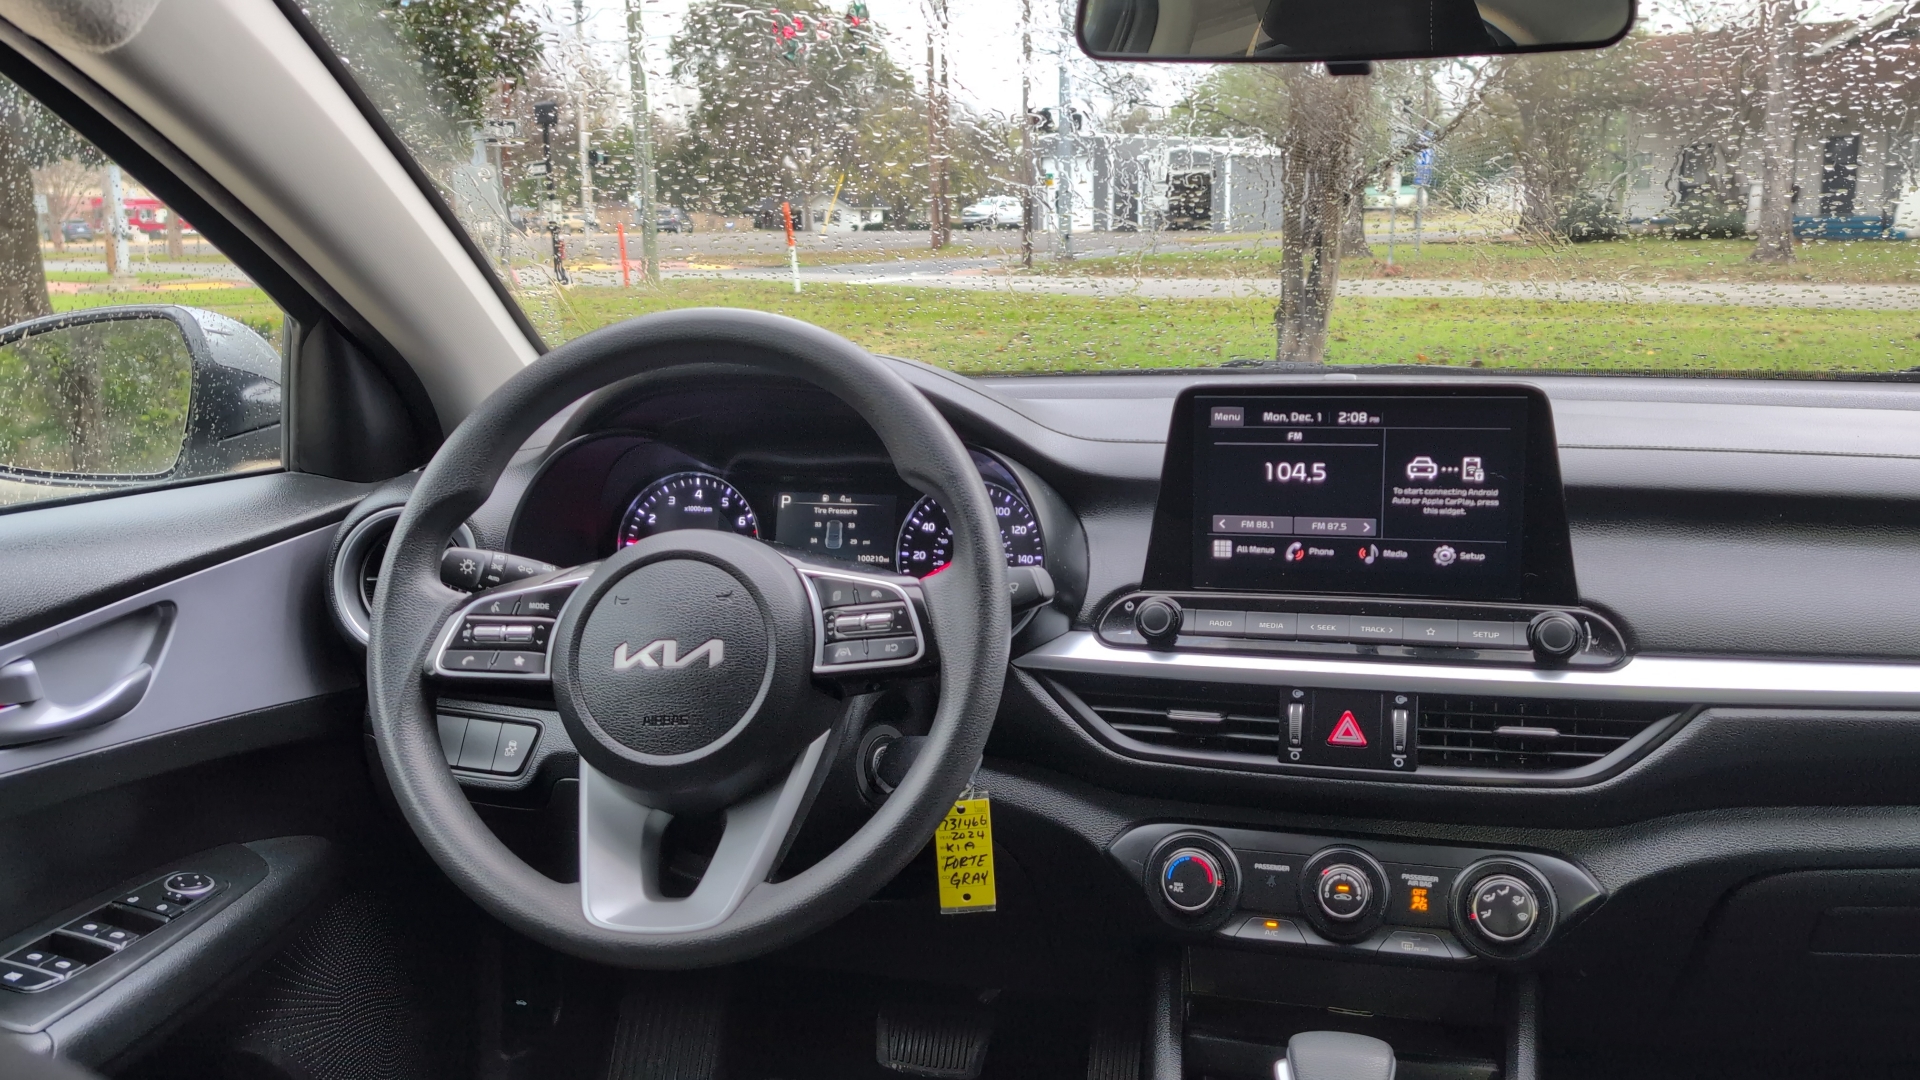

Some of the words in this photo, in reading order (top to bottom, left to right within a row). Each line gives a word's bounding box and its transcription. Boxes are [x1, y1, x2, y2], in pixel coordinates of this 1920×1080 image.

[1214, 412, 1241, 421] Menu
[1290, 412, 1314, 422] Dec.
[1317, 412, 1322, 422] 1
[1338, 412, 1368, 423] 2:08
[1287, 432, 1303, 441] FM
[1265, 462, 1327, 482] 104.5
[694, 490, 702, 498] 4
[1424, 488, 1467, 497] connecting
[668, 496, 676, 505] 3
[722, 498, 729, 506] 5
[781, 496, 791, 508] P
[995, 507, 1010, 516] 100
[648, 514, 656, 523] 2
[738, 516, 746, 526] 6
[922, 522, 935, 532] 40
[1012, 526, 1027, 534] 120
[1241, 521, 1255, 529] FM
[1256, 521, 1274, 530] 88.1
[1312, 522, 1326, 530] FM
[1326, 522, 1347, 531] 87.5
[1236, 545, 1248, 553] All
[1249, 546, 1275, 554] Menus
[1309, 548, 1334, 556] Phone
[1383, 550, 1408, 558] Media
[913, 551, 926, 559] 20
[1018, 555, 1033, 564] 140
[1460, 552, 1485, 561] Setup
[529, 602, 549, 610] MODE
[1472, 631, 1500, 639] SETUP
[614, 639, 724, 669] KIA
[943, 815, 987, 831] 731466
[951, 830, 985, 840] 2024
[946, 841, 975, 852] KIA
[944, 854, 988, 872] FORTE
[1254, 863, 1290, 872] PASSENGER
[950, 870, 988, 889] GRAY
[1401, 873, 1439, 882] PASSENGER
[1412, 888, 1427, 896] OFF
